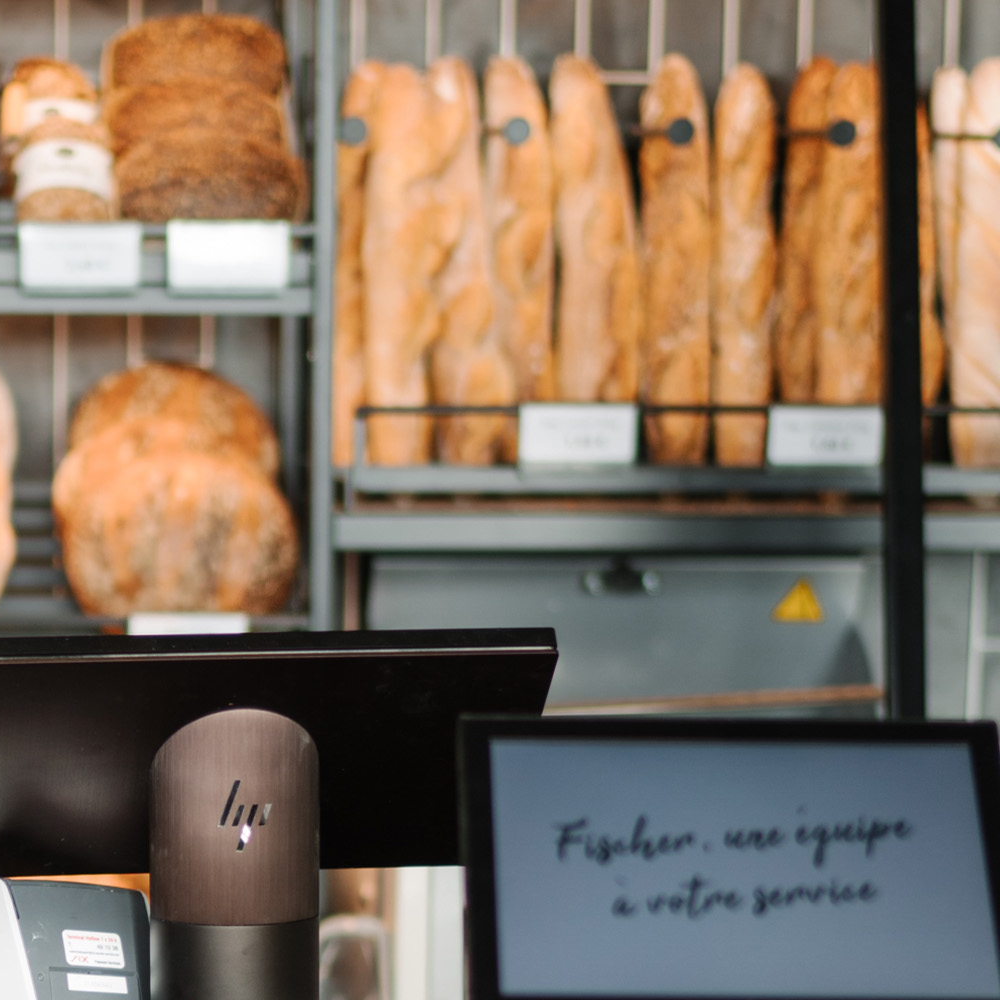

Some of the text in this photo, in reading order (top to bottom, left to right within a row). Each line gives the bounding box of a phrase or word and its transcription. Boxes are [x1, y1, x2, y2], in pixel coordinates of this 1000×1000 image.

[723, 826, 786, 851] une
[794, 804, 914, 869] équipe
[646, 872, 742, 920] votre
[752, 876, 877, 917] service
